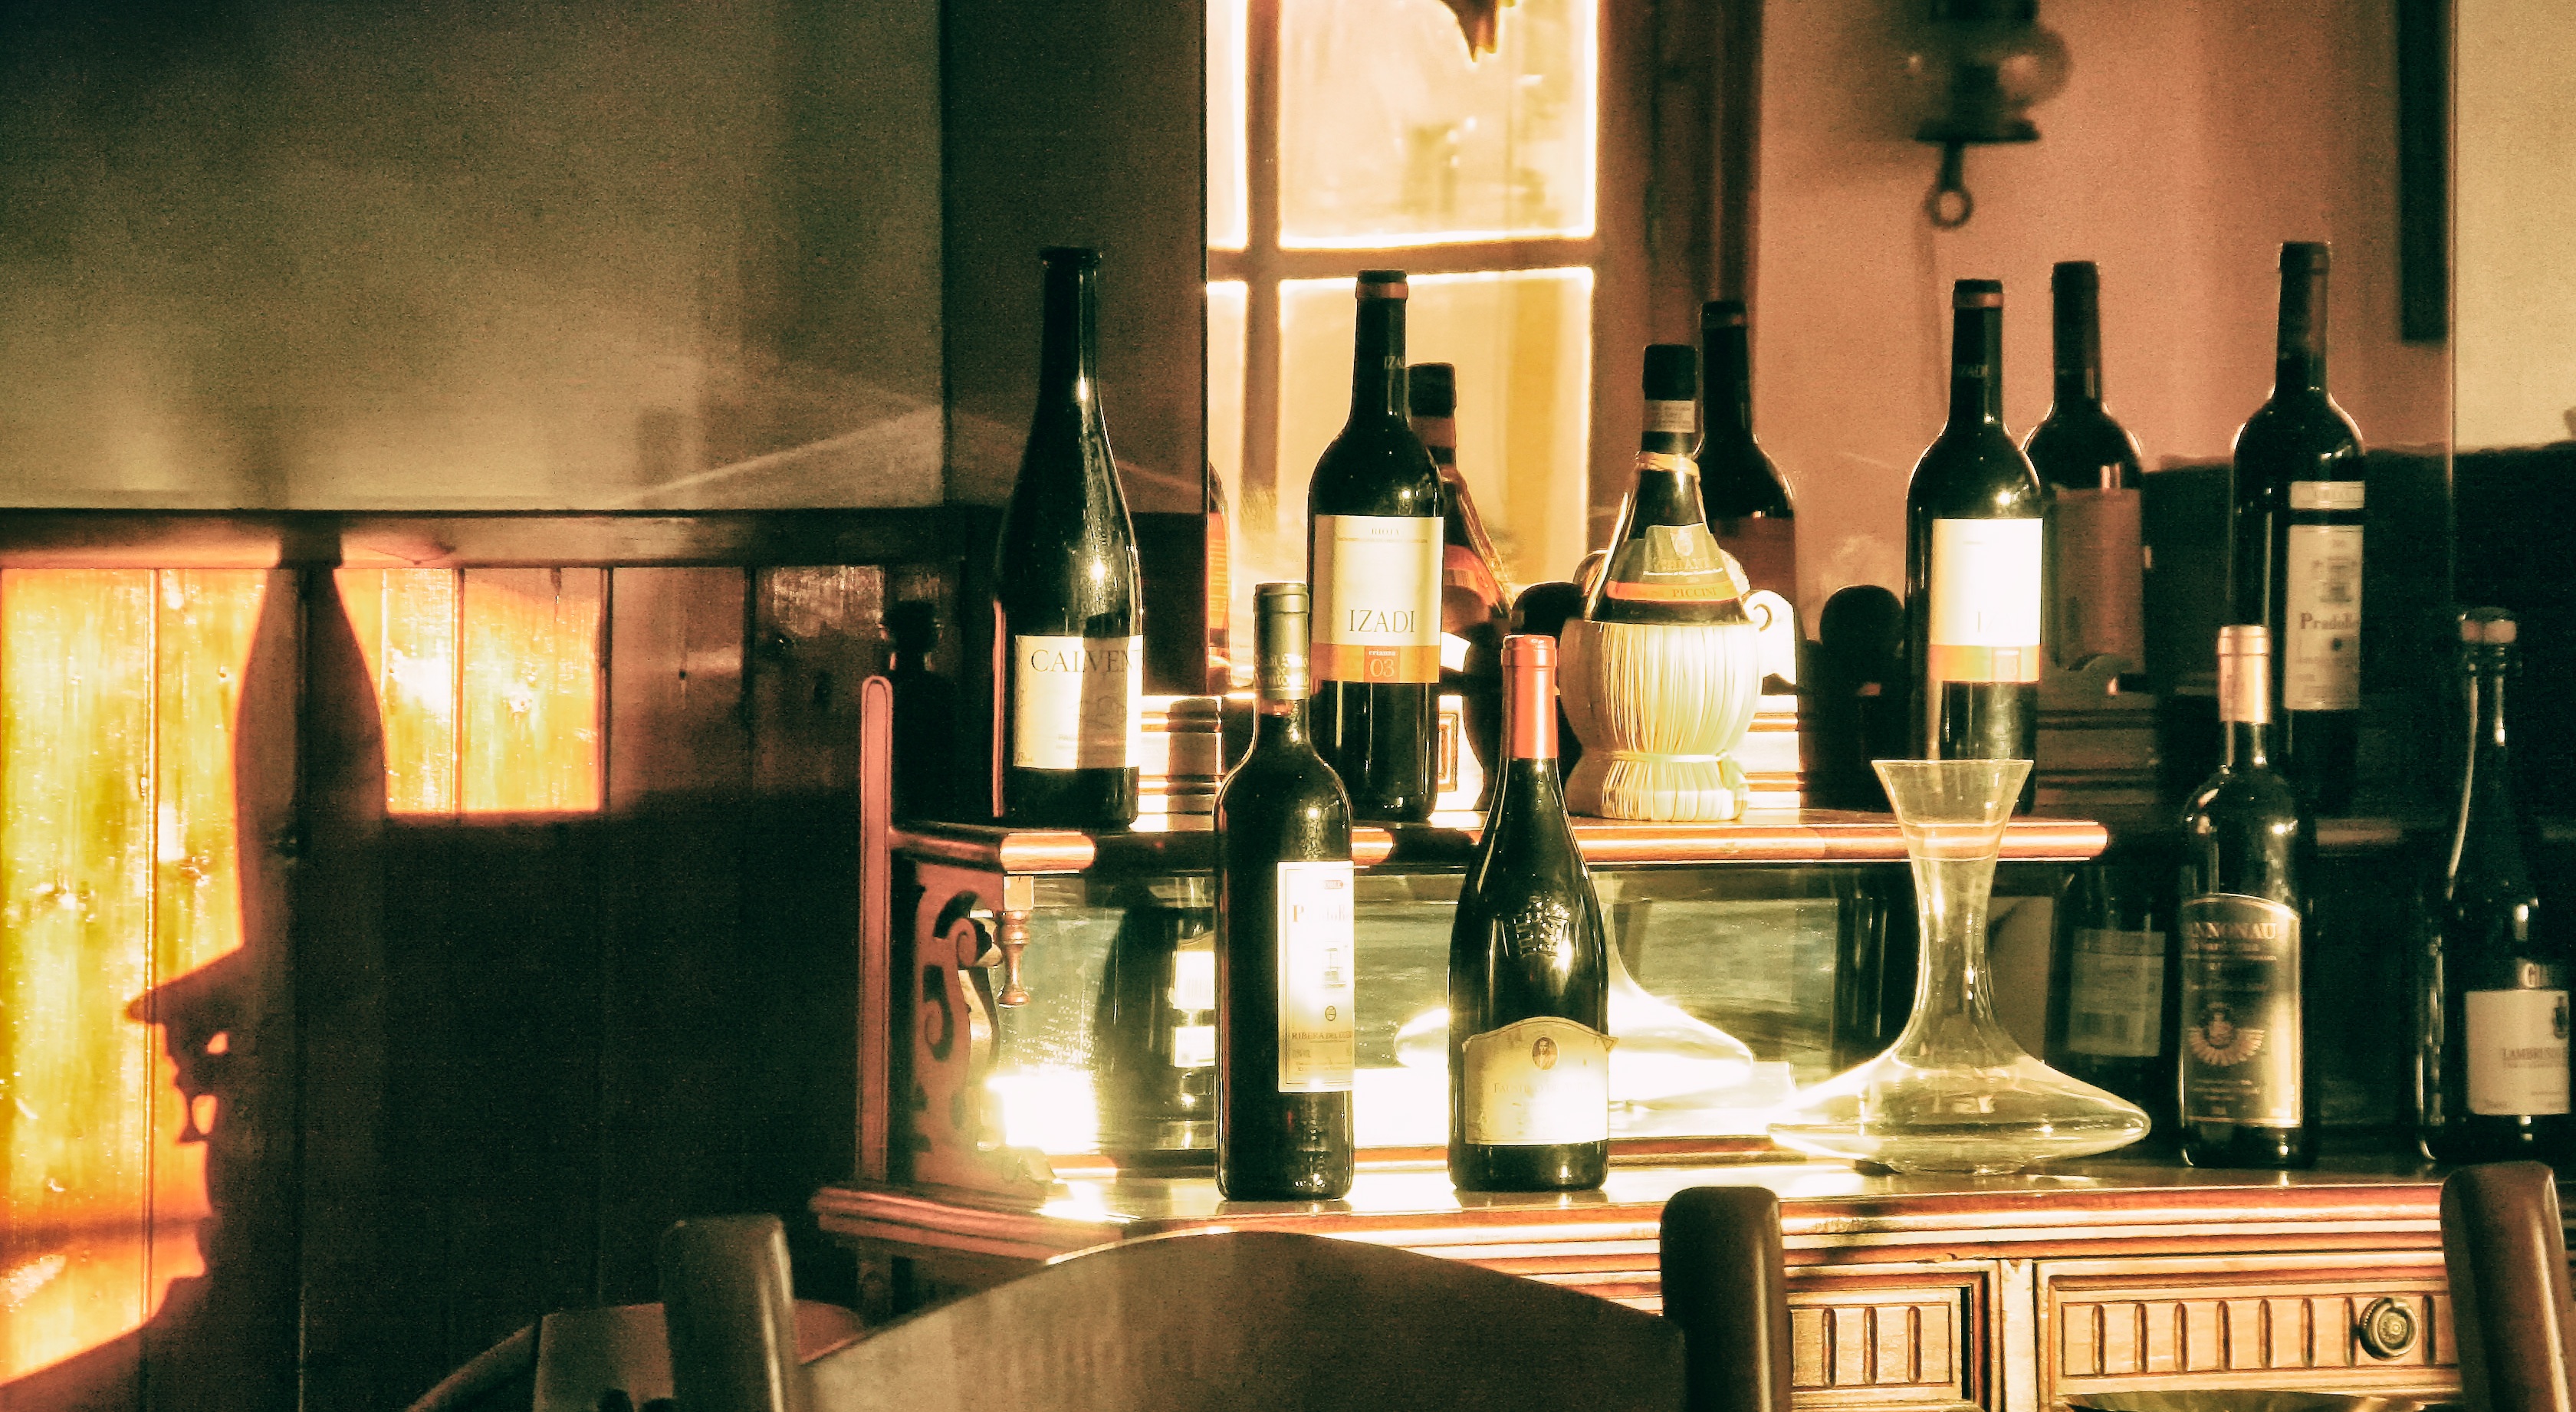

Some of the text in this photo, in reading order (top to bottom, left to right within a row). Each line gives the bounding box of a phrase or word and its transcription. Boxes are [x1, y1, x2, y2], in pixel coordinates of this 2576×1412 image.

[1672, 586, 1717, 598] PICCINI
[1349, 609, 1415, 633] IZADI
[1369, 658, 1395, 678] 03
